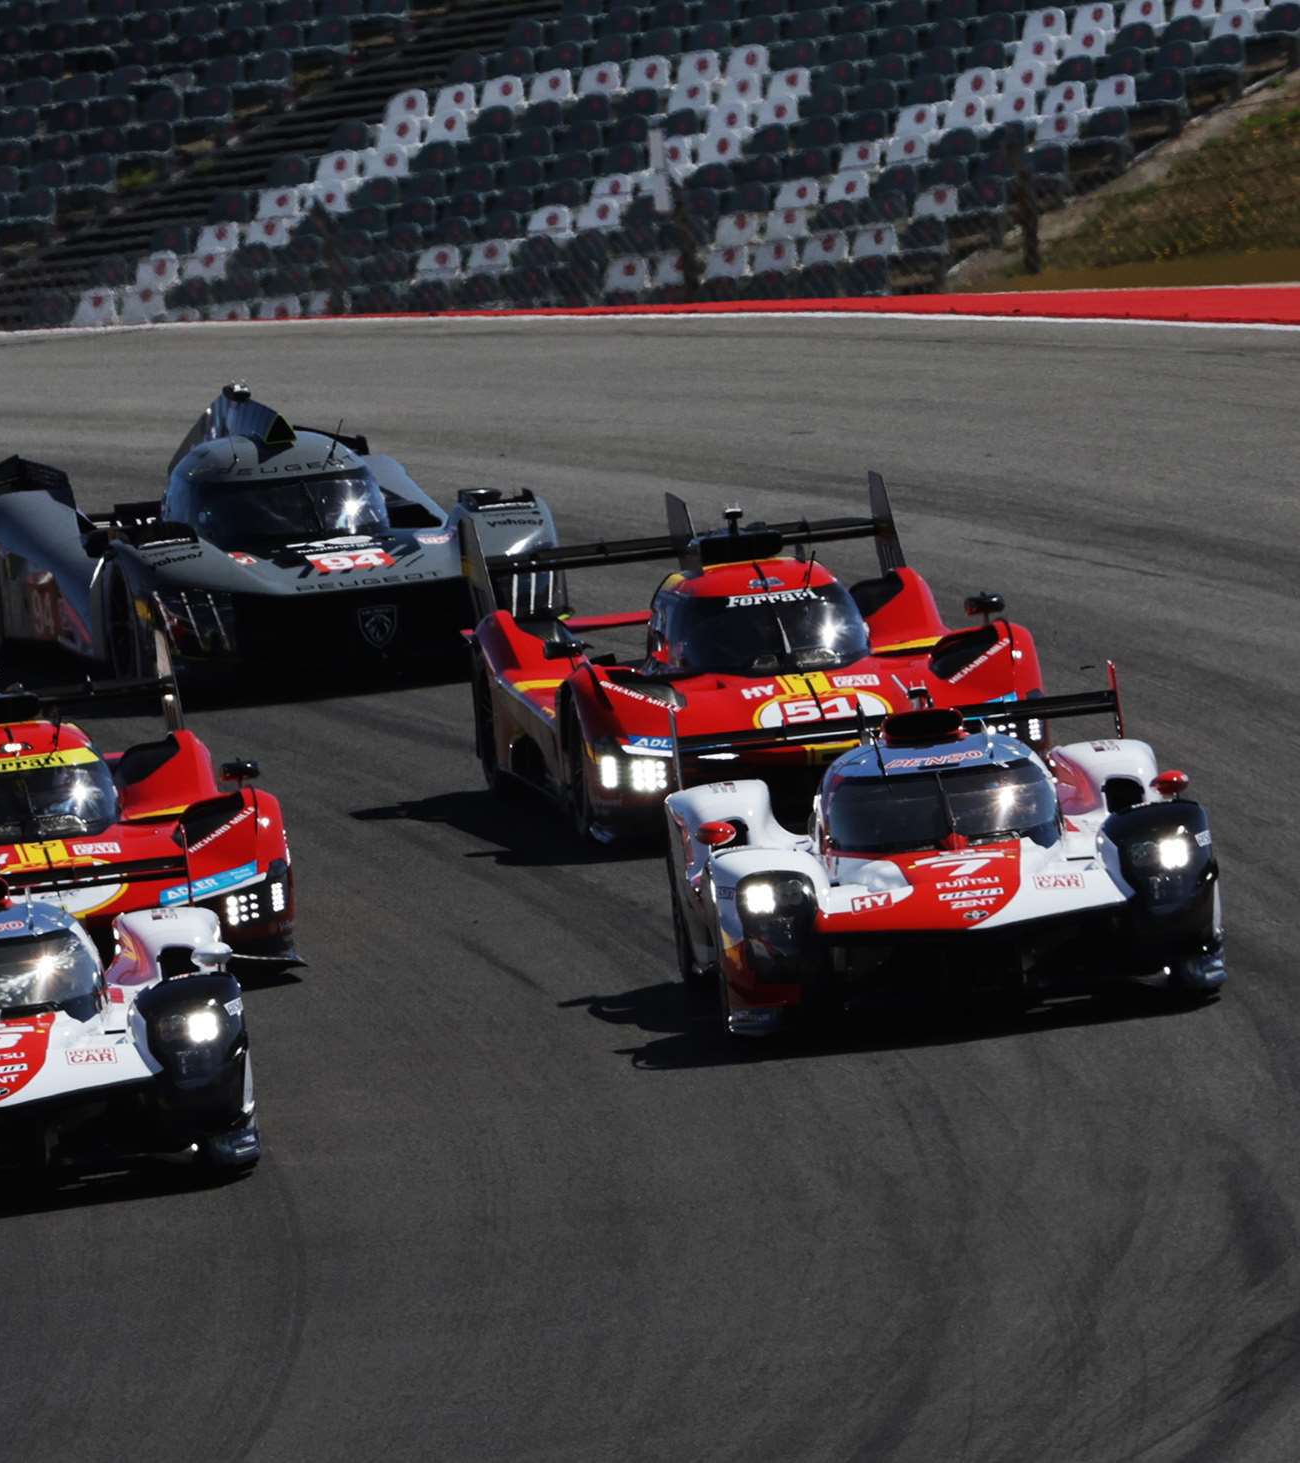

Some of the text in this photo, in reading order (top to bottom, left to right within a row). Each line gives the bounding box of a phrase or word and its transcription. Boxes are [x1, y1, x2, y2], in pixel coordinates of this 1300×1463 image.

[319, 552, 387, 571] 94
[295, 569, 444, 593] PEUGEOT
[726, 587, 819, 608] Ferrari
[740, 684, 776, 700] HY
[783, 696, 858, 724] 51
[633, 737, 674, 749] ADL
[930, 858, 993, 877] 7
[935, 876, 1000, 891] FUJITSU
[1039, 879, 1082, 889] CAR
[853, 893, 890, 913] HY
[951, 897, 997, 909] ZENT
[70, 1053, 114, 1065] CAR
